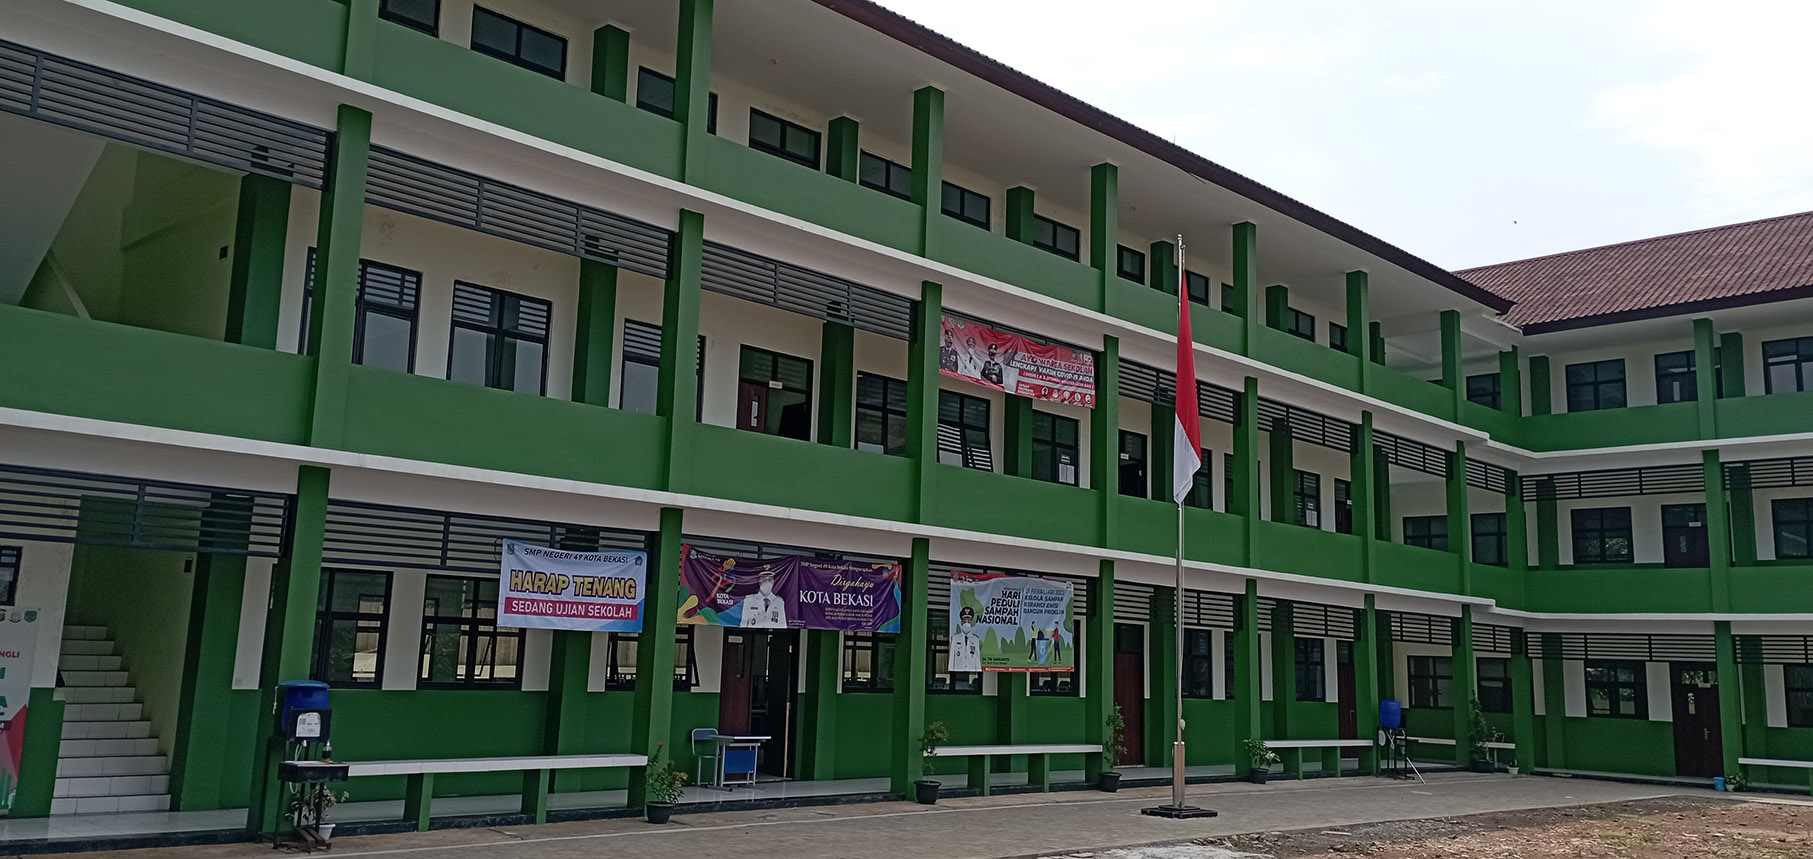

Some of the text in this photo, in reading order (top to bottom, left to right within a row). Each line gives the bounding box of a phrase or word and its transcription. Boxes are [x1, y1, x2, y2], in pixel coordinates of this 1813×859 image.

[1021, 354, 1038, 364] AYO
[524, 547, 628, 564] SMP NEGERI 49 KOTA BEKASI
[509, 569, 637, 600] HARAP TENANG
[830, 573, 875, 593] Dirgahayu
[800, 590, 873, 607] KOTA BEKASI
[1001, 590, 1021, 600] HARI
[511, 600, 633, 618] SEDANG UJIAN SEKOLAH
[990, 598, 1020, 608] PEDULI
[984, 606, 1019, 616] SAMPAH
[975, 615, 1018, 625] NASIONAL
